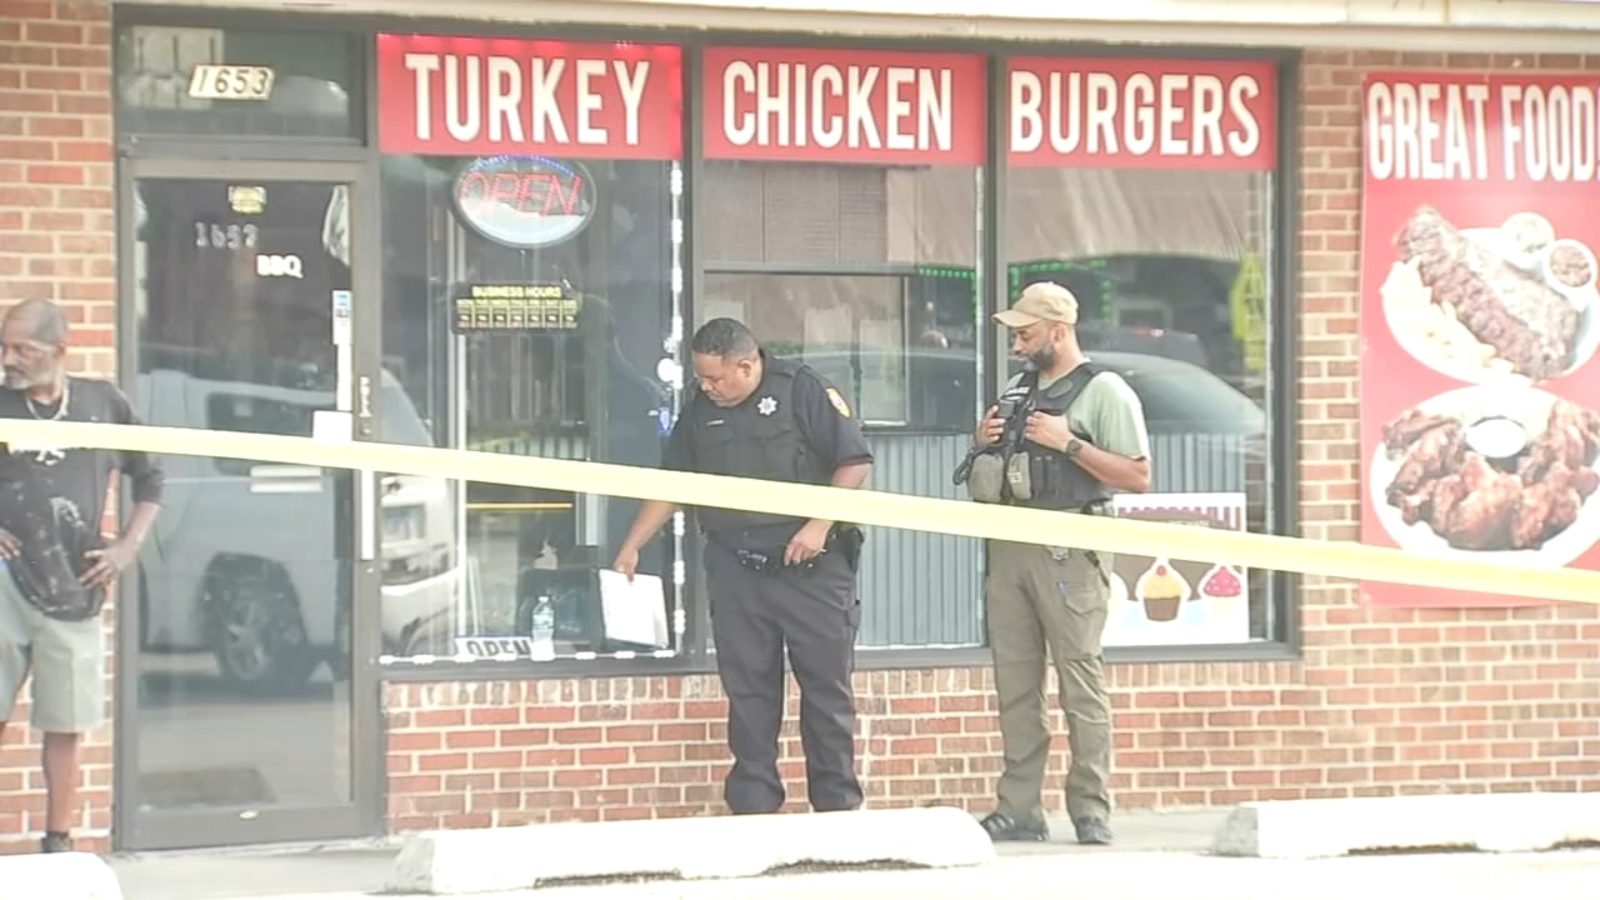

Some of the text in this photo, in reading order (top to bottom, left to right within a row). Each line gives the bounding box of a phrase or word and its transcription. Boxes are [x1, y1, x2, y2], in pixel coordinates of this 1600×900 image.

[198, 68, 269, 95] 1653
[405, 52, 651, 145] TURKEY
[723, 60, 953, 152] CHICKEN
[1010, 69, 1260, 157] BURGERS
[1367, 81, 1600, 181] GREAT FOOD
[460, 170, 584, 217] OPEN
[257, 255, 304, 279] BBQ
[525, 286, 561, 298] HOURS
